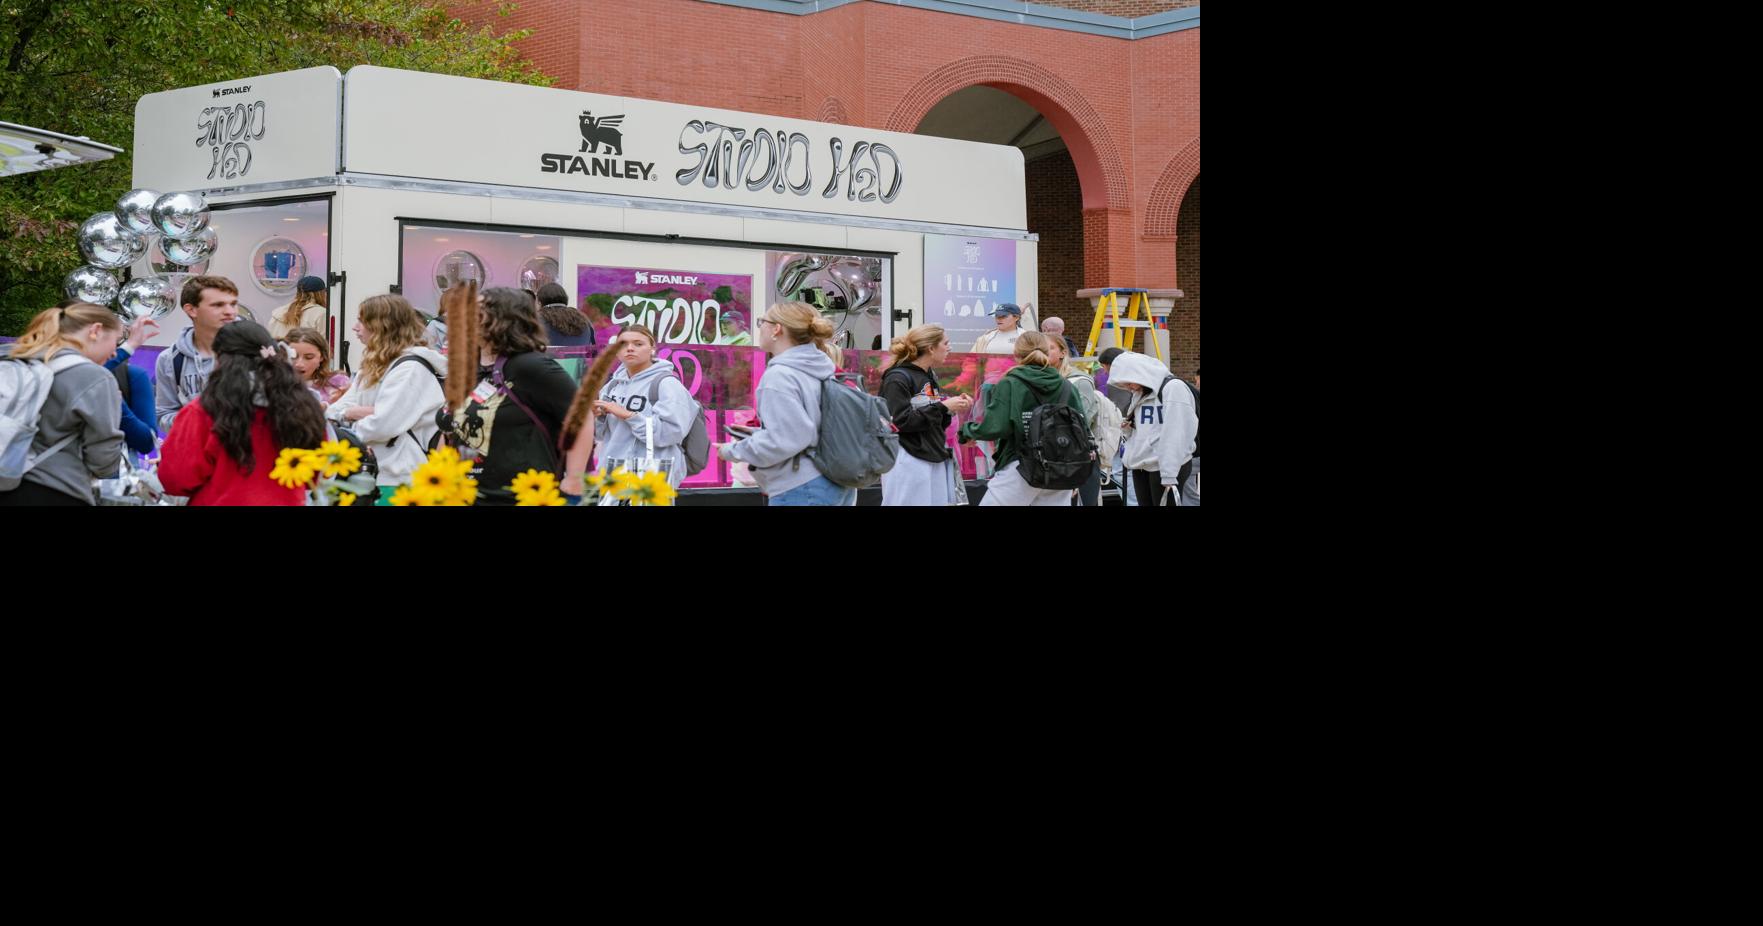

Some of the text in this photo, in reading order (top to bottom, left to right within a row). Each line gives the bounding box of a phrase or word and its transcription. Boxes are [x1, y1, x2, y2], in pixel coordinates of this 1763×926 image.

[221, 85, 252, 96] STANLEY
[195, 100, 266, 148] STUDIO
[541, 153, 655, 181] STANLEY
[675, 119, 812, 196] STUDIO
[650, 274, 698, 286] STANLEY
